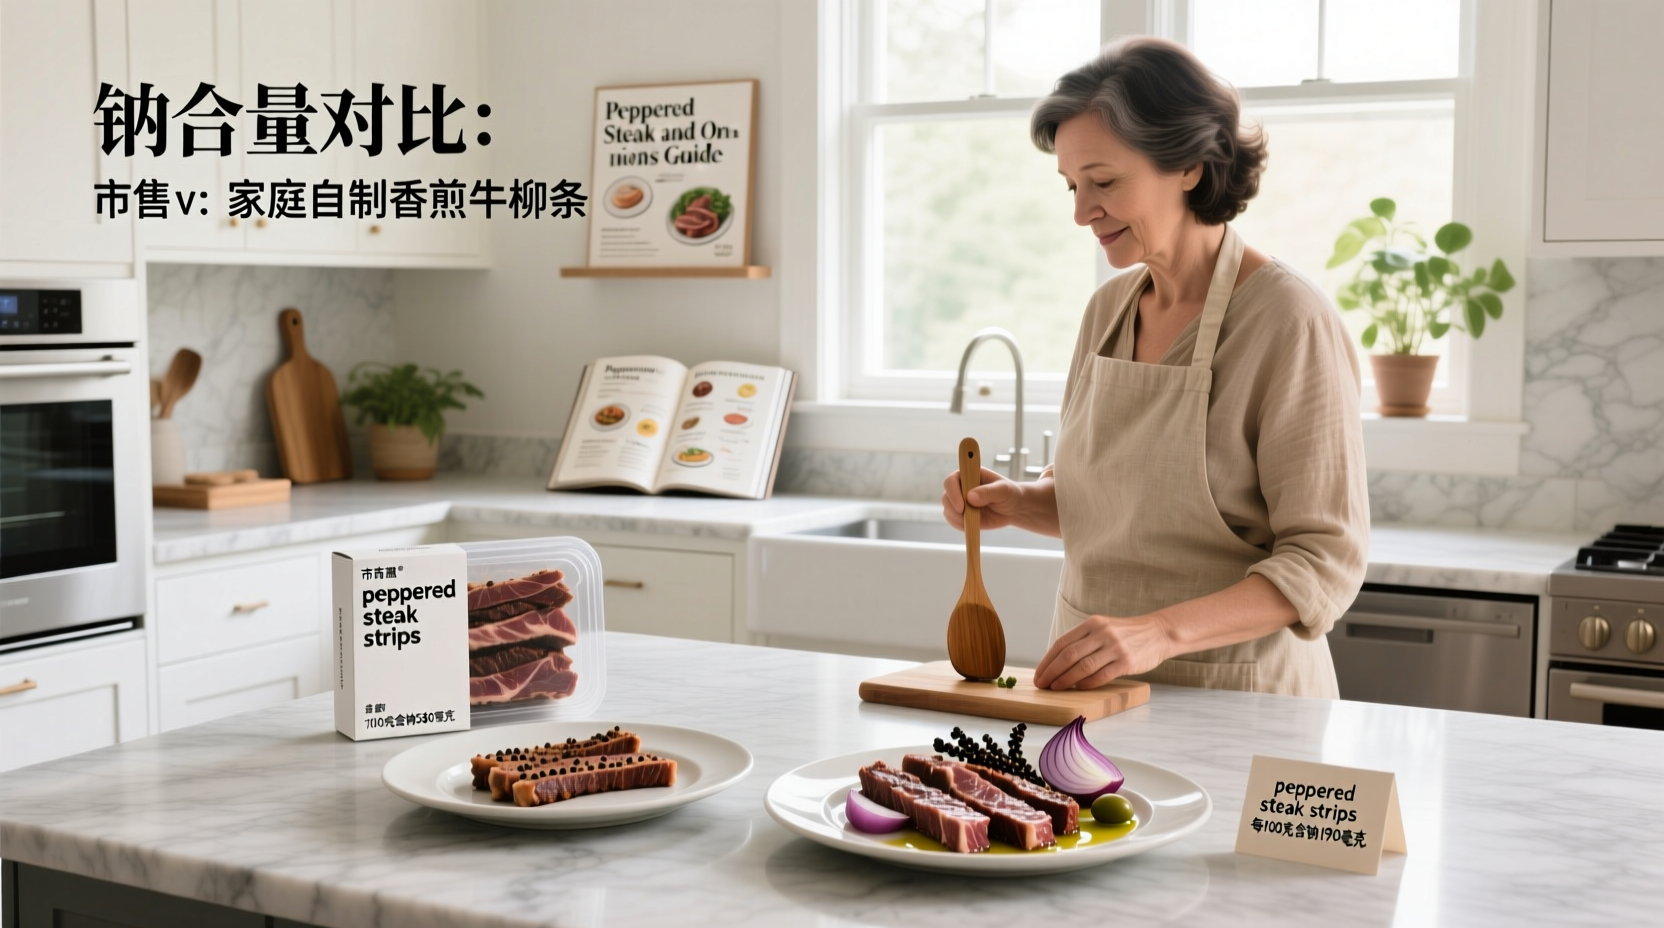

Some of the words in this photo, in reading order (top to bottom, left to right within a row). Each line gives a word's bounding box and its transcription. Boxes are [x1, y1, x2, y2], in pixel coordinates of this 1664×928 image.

[604, 97, 695, 124] Peppered
[603, 123, 655, 144] Steak
[661, 121, 696, 142] and
[664, 143, 724, 166] Guide
[362, 578, 456, 607] peppered
[362, 604, 419, 627] steak
[363, 626, 421, 650] strips
[1273, 781, 1357, 802] peppered
[1259, 797, 1305, 817] steak
[1309, 803, 1357, 825] strips
